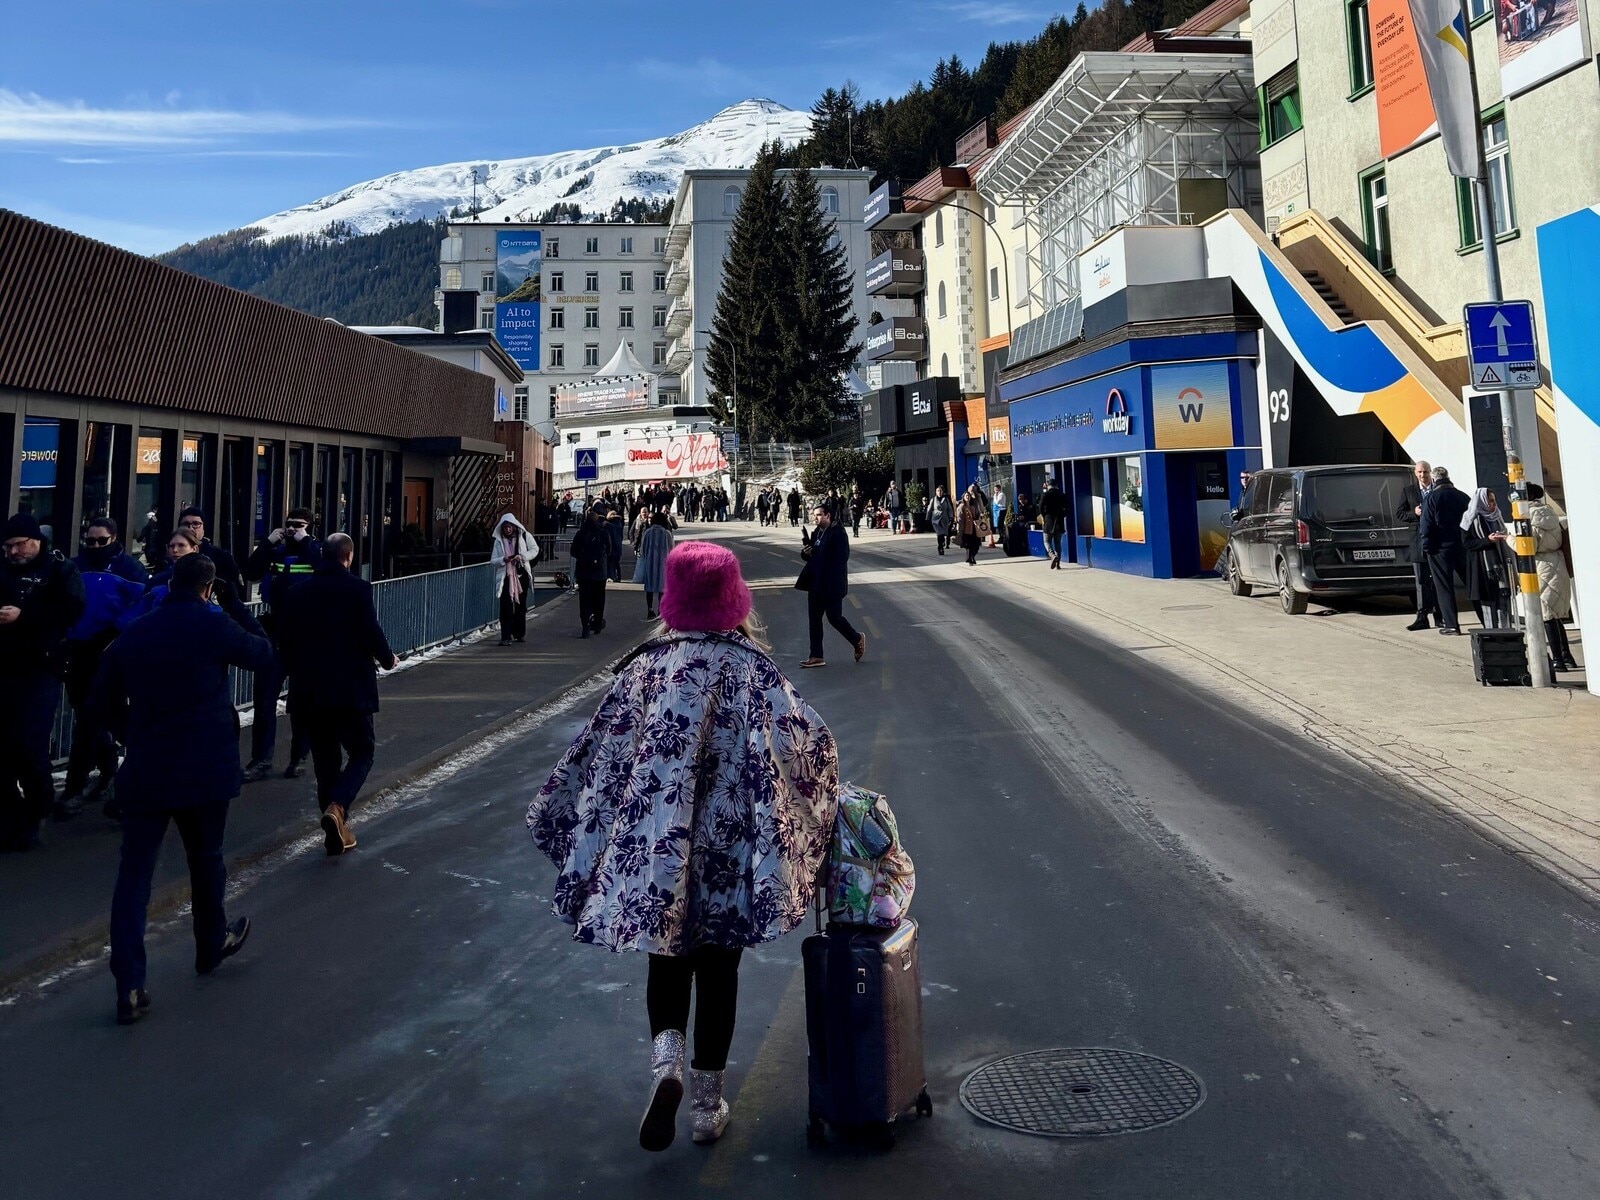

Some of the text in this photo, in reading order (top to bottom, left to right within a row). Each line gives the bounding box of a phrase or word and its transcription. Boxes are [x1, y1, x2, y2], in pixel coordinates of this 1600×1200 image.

[1375, 12, 1395, 30] POWERING
[1384, 20, 1399, 34] FUTURE
[1399, 16, 1404, 24] OF
[1377, 26, 1405, 48] EVERYDAY LIFE
[506, 308, 531, 317] AI to
[501, 318, 536, 330] impact
[867, 332, 886, 350] Enterprise
[577, 396, 607, 404] OPPORTUNITY
[920, 400, 931, 414] C3.ai
[1270, 388, 1289, 423] 93
[1102, 410, 1129, 435] workday
[1179, 404, 1203, 423] W
[635, 449, 663, 461] Pinterest
